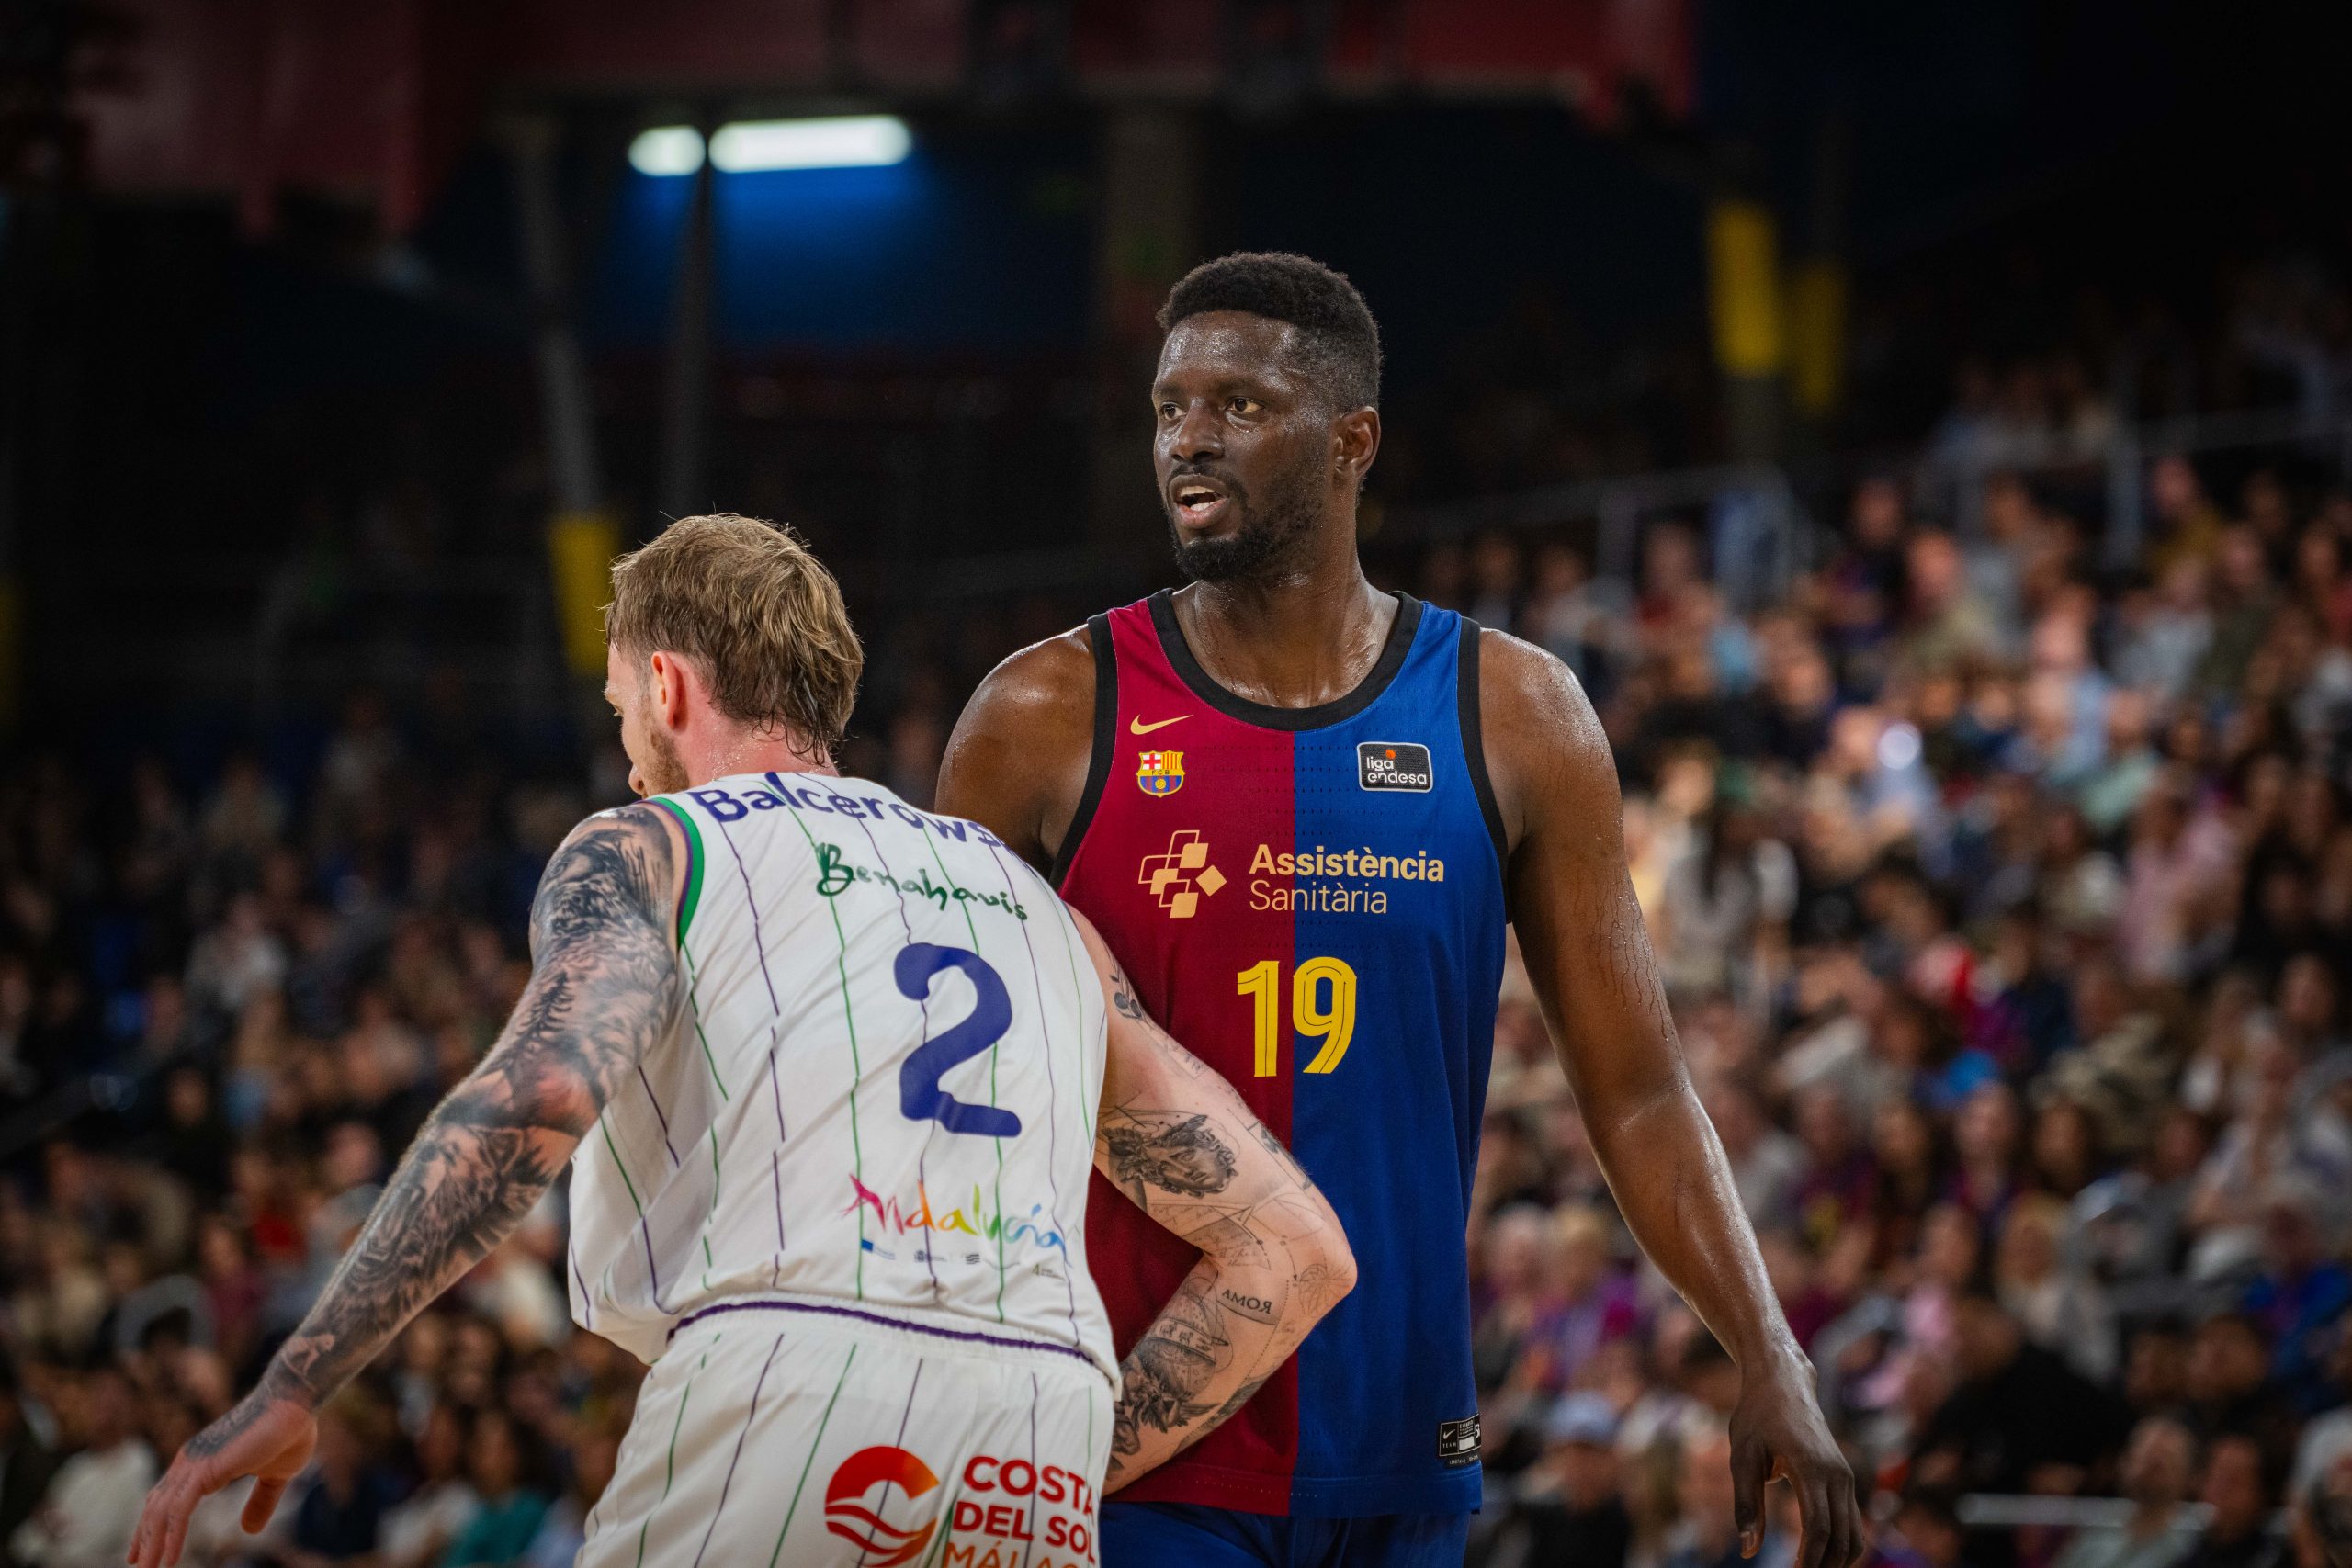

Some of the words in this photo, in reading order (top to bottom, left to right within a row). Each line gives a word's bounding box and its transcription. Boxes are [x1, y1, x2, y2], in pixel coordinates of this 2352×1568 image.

[1366, 756, 1395, 772] liga
[1367, 770, 1427, 784] endesa
[689, 771, 1012, 851] Balcerows
[1249, 843, 1444, 883] Assistència
[1249, 879, 1388, 915] Sanitària
[1237, 956, 1358, 1077] 19
[893, 942, 1022, 1138] 2
[952, 1500, 1035, 1542] DEL
